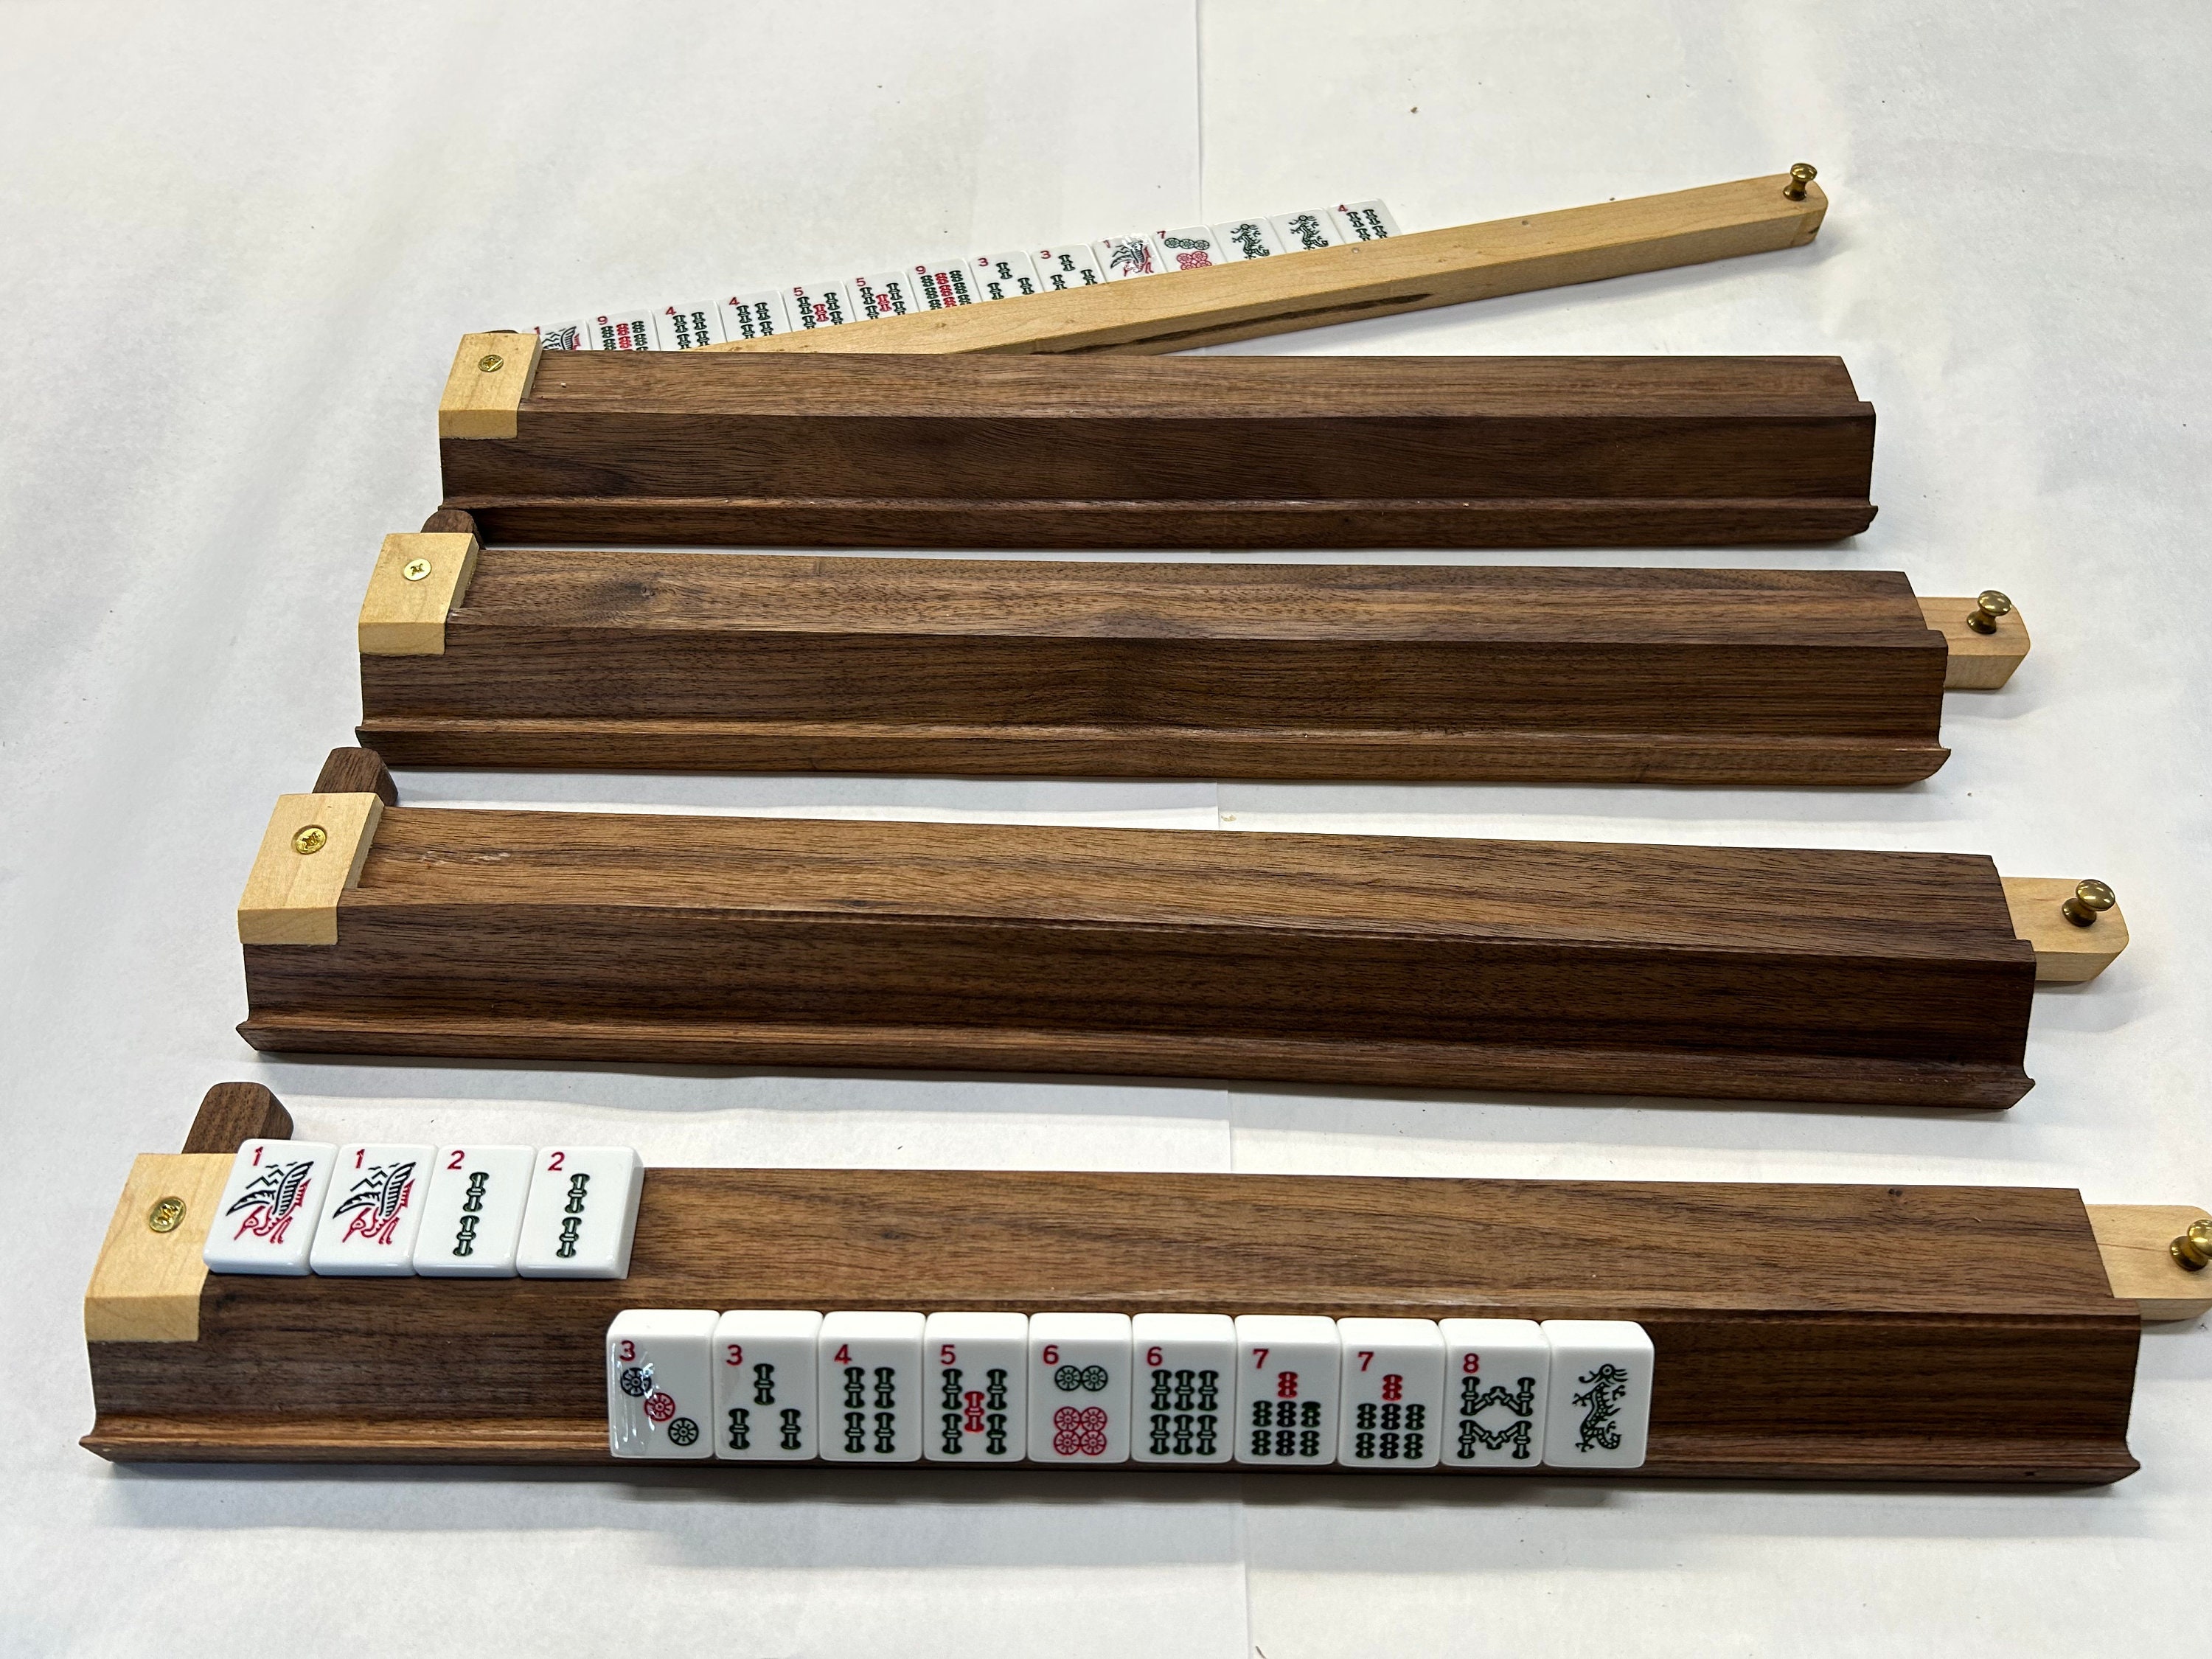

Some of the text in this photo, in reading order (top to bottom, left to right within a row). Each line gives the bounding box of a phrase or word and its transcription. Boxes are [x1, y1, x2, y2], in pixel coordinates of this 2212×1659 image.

[1157, 230, 1166, 239] 7
[979, 257, 989, 267] 3
[1042, 250, 1051, 259] 3
[915, 265, 927, 275] 9
[793, 287, 804, 296] 5
[856, 277, 866, 287] 5
[729, 297, 740, 306] 4
[597, 316, 608, 325] 9
[665, 307, 676, 316] 4
[252, 1147, 262, 1166] 1
[355, 1149, 364, 1169] 1
[447, 1150, 465, 1170] 2
[548, 1151, 565, 1172] 2
[620, 1340, 636, 1362] 3
[726, 1345, 742, 1366] 3
[834, 1345, 851, 1365] 4
[941, 1345, 956, 1366] 5
[1043, 1345, 1059, 1366] 6
[1147, 1347, 1163, 1367] 6
[1253, 1349, 1269, 1368] 7
[1357, 1352, 1374, 1372] 7
[1463, 1354, 1479, 1374] 8
